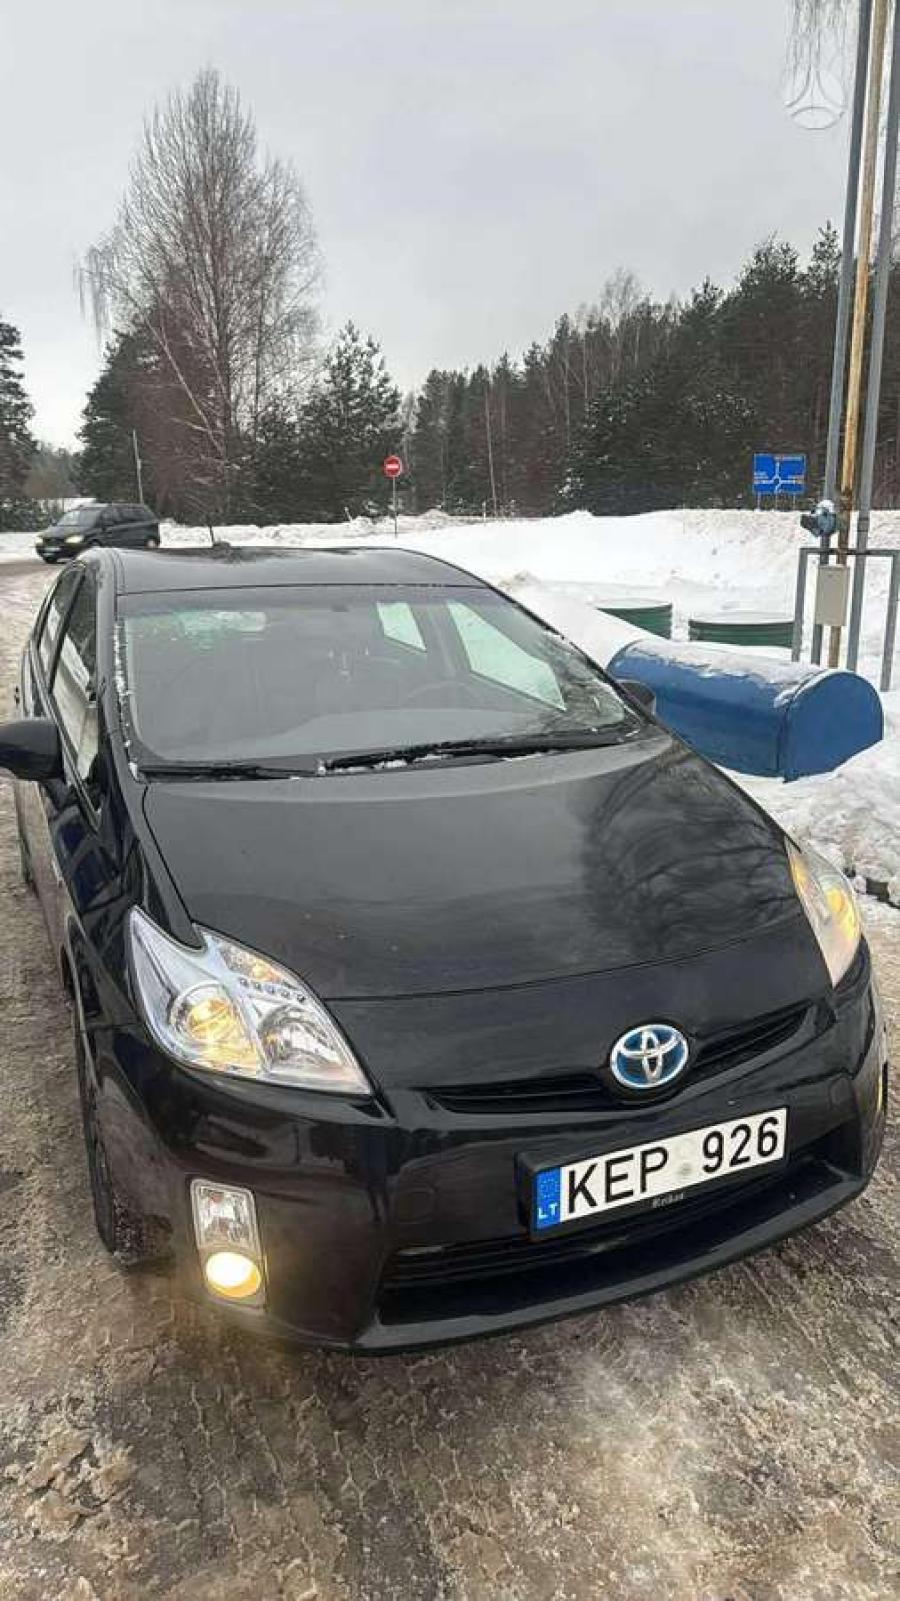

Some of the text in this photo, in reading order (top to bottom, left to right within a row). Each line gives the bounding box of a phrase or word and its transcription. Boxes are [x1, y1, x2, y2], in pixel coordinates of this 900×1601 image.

[567, 1116, 779, 1213] KEP 926
[538, 1203, 558, 1220] LT
